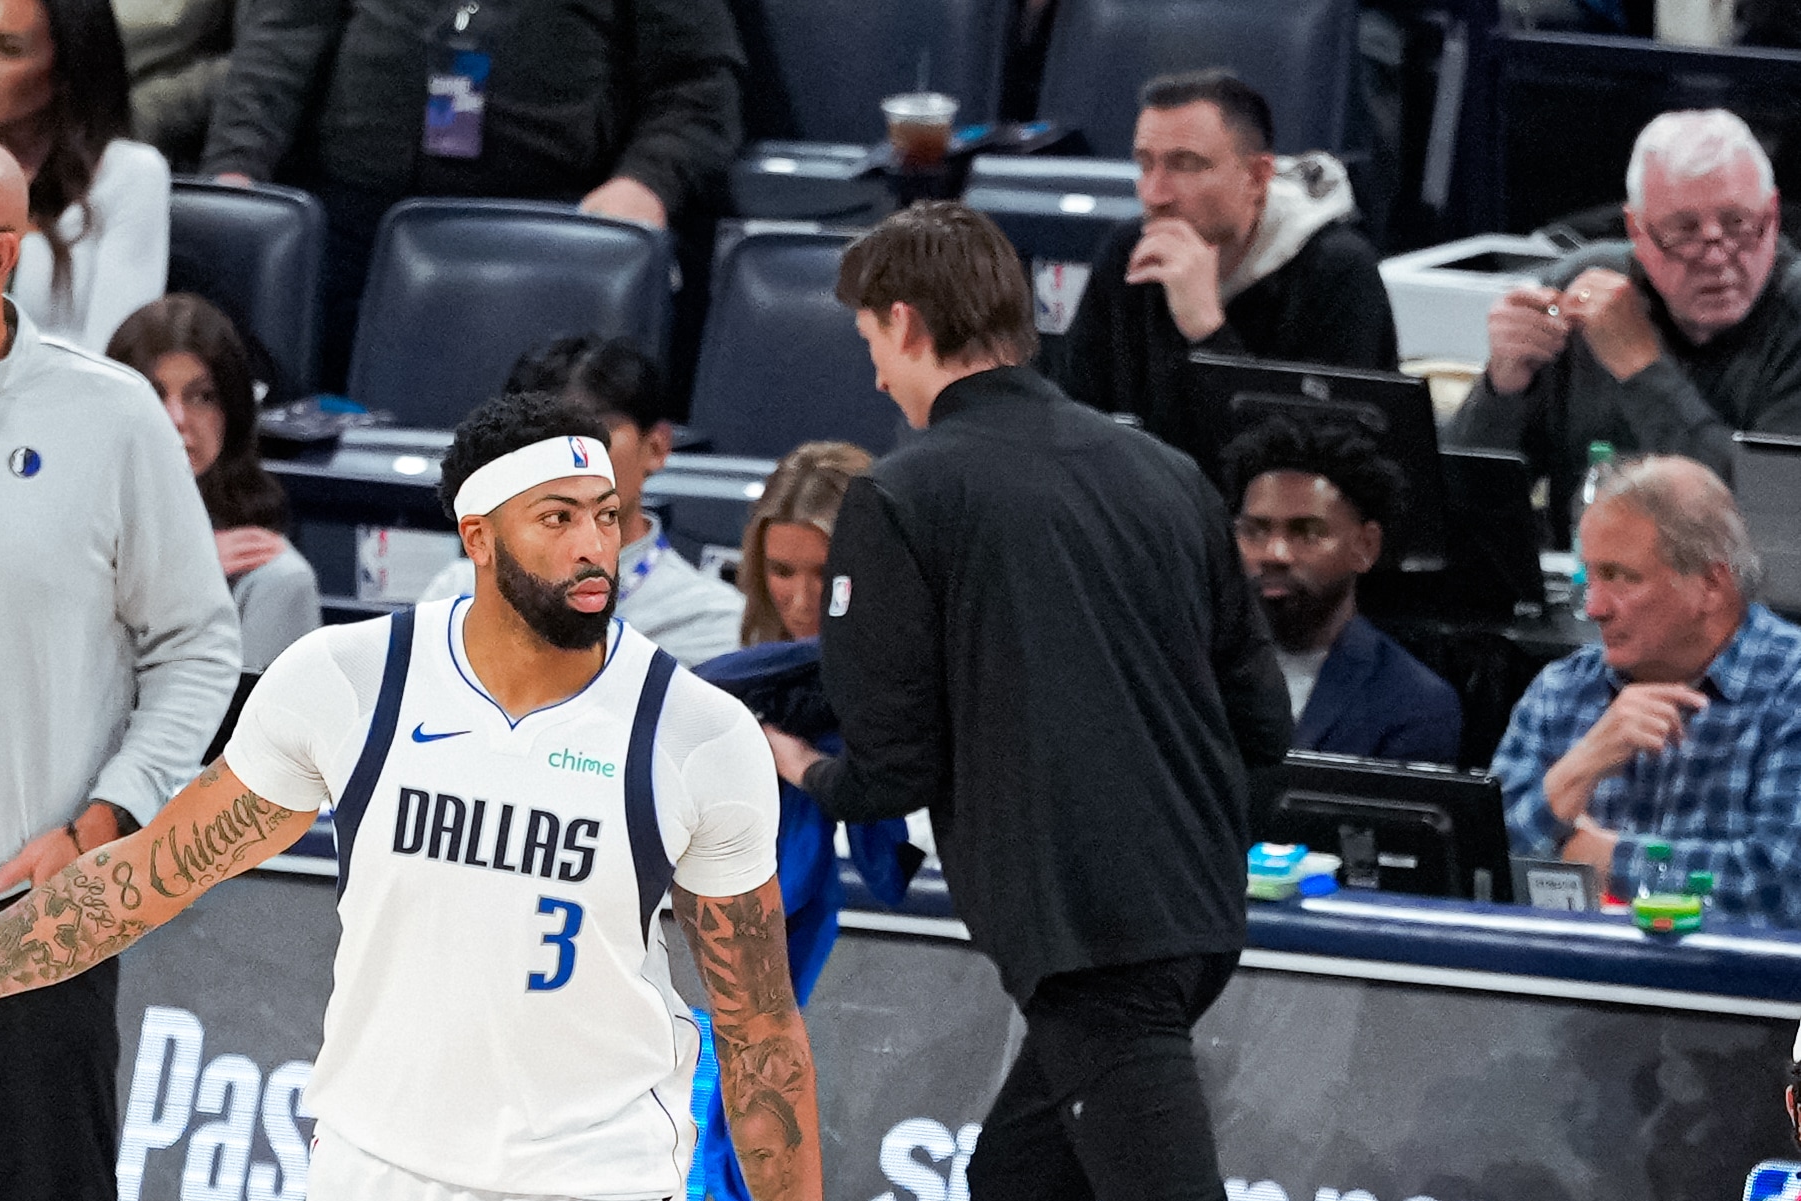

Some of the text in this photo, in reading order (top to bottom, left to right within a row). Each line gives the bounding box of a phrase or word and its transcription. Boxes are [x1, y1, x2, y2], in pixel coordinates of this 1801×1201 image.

[548, 748, 616, 777] chime
[391, 784, 603, 885] DALLAS
[524, 894, 586, 993] 3
